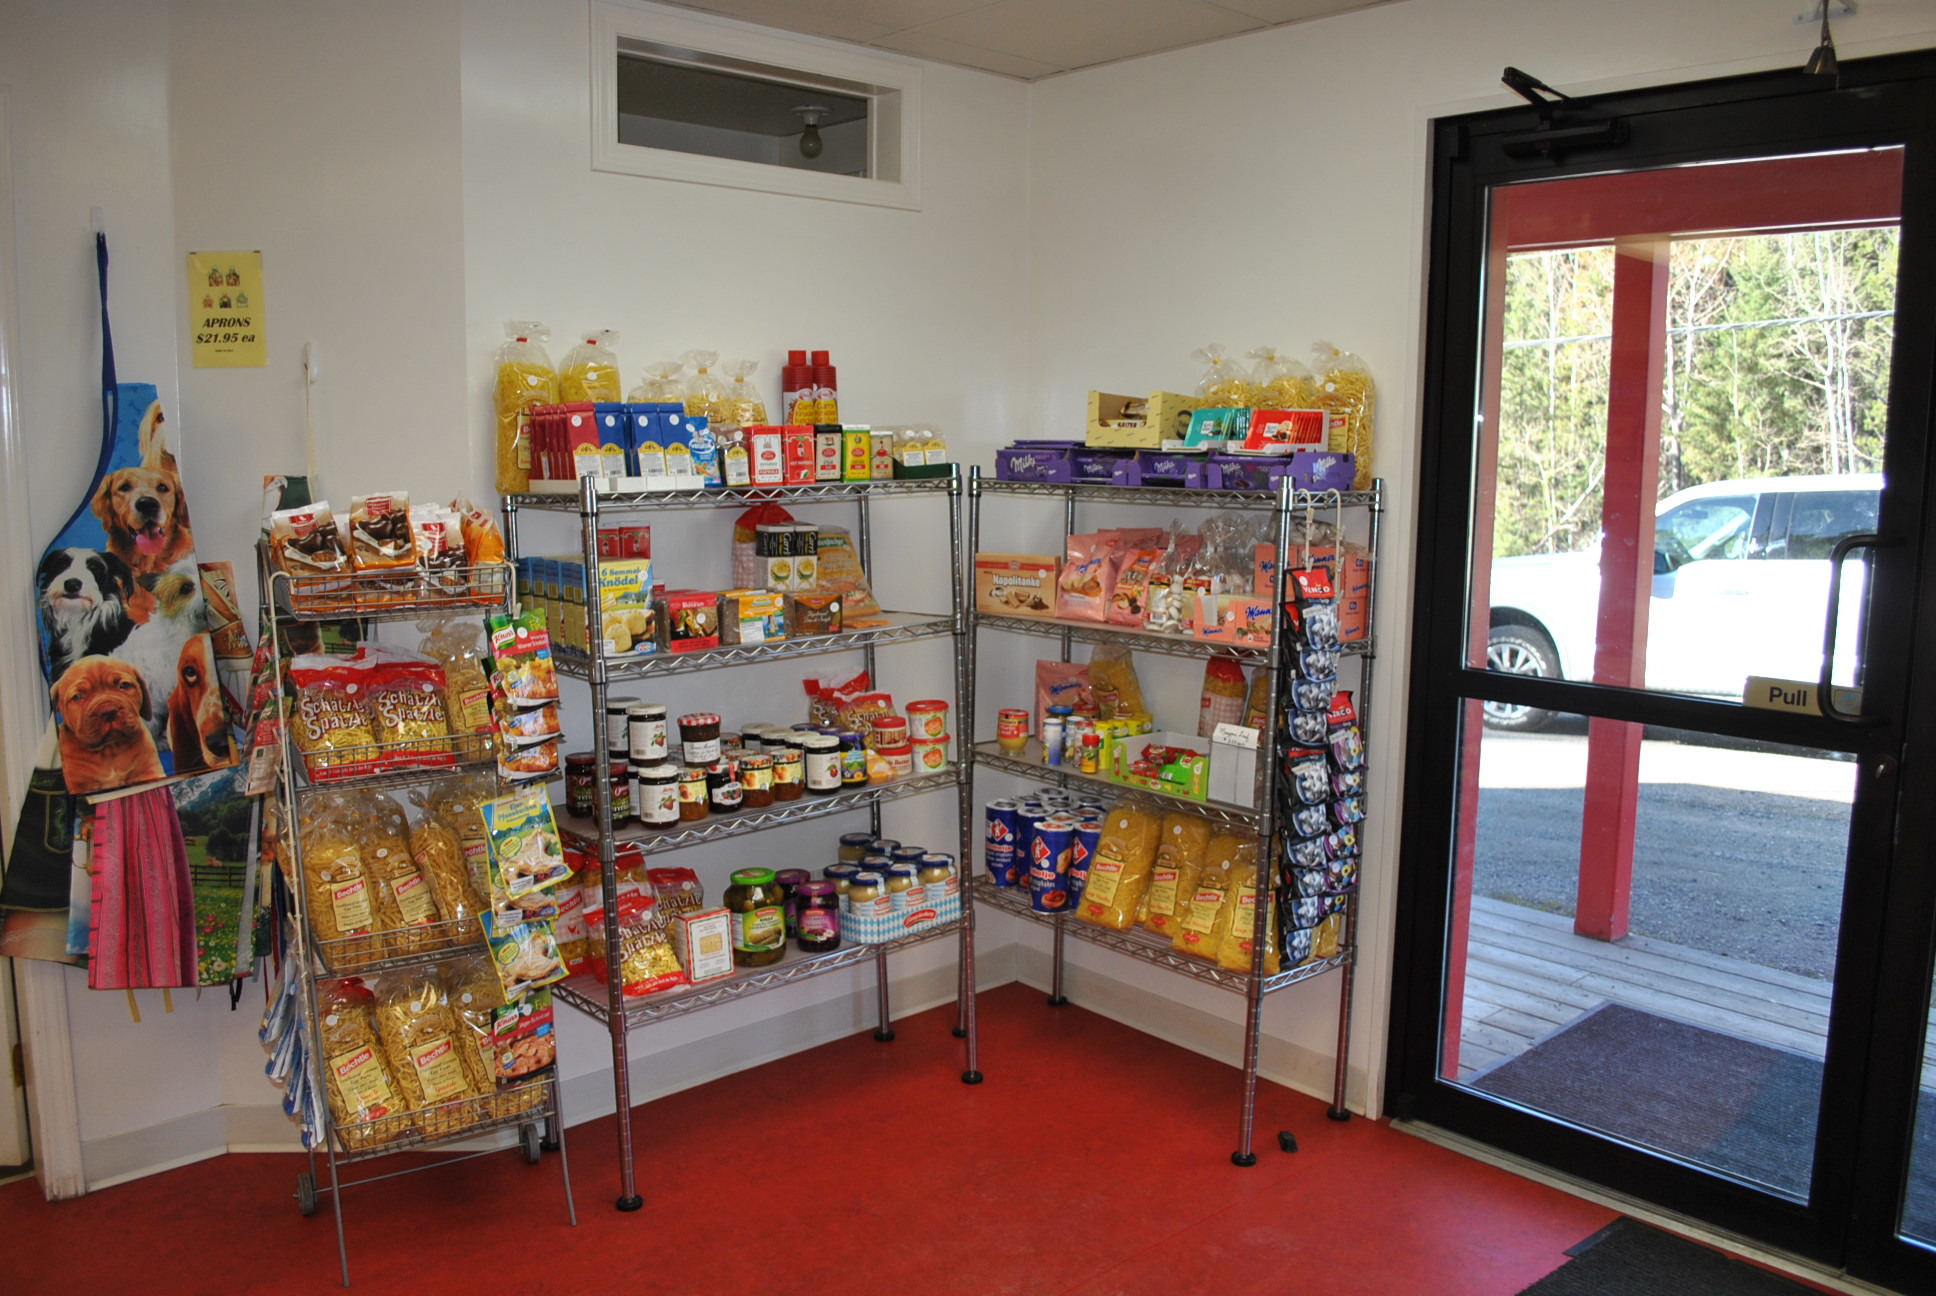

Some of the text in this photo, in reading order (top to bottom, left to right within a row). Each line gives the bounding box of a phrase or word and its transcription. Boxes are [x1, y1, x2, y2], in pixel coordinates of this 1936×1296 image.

[203, 317, 251, 328] APRONS
[196, 333, 256, 344] $21.95 ea
[1010, 454, 1036, 473] Milka
[1083, 463, 1103, 473] Milka
[1154, 460, 1176, 473] Milka
[1220, 462, 1241, 474] Milka
[1316, 455, 1337, 470] Milka
[601, 567, 608, 577] 6
[599, 575, 639, 588] Knödel
[992, 574, 1041, 588] Napolitanke
[1302, 585, 1331, 594] VENCO
[1245, 605, 1273, 620] Mann
[1049, 682, 1082, 695] Manner
[1768, 686, 1807, 707] Pull
[306, 712, 368, 740] Spätzle
[336, 882, 363, 898] Bechtle
[496, 1014, 518, 1029] Knorr
[420, 1044, 449, 1065] Bechtle
[339, 1052, 370, 1075] Bechtle
